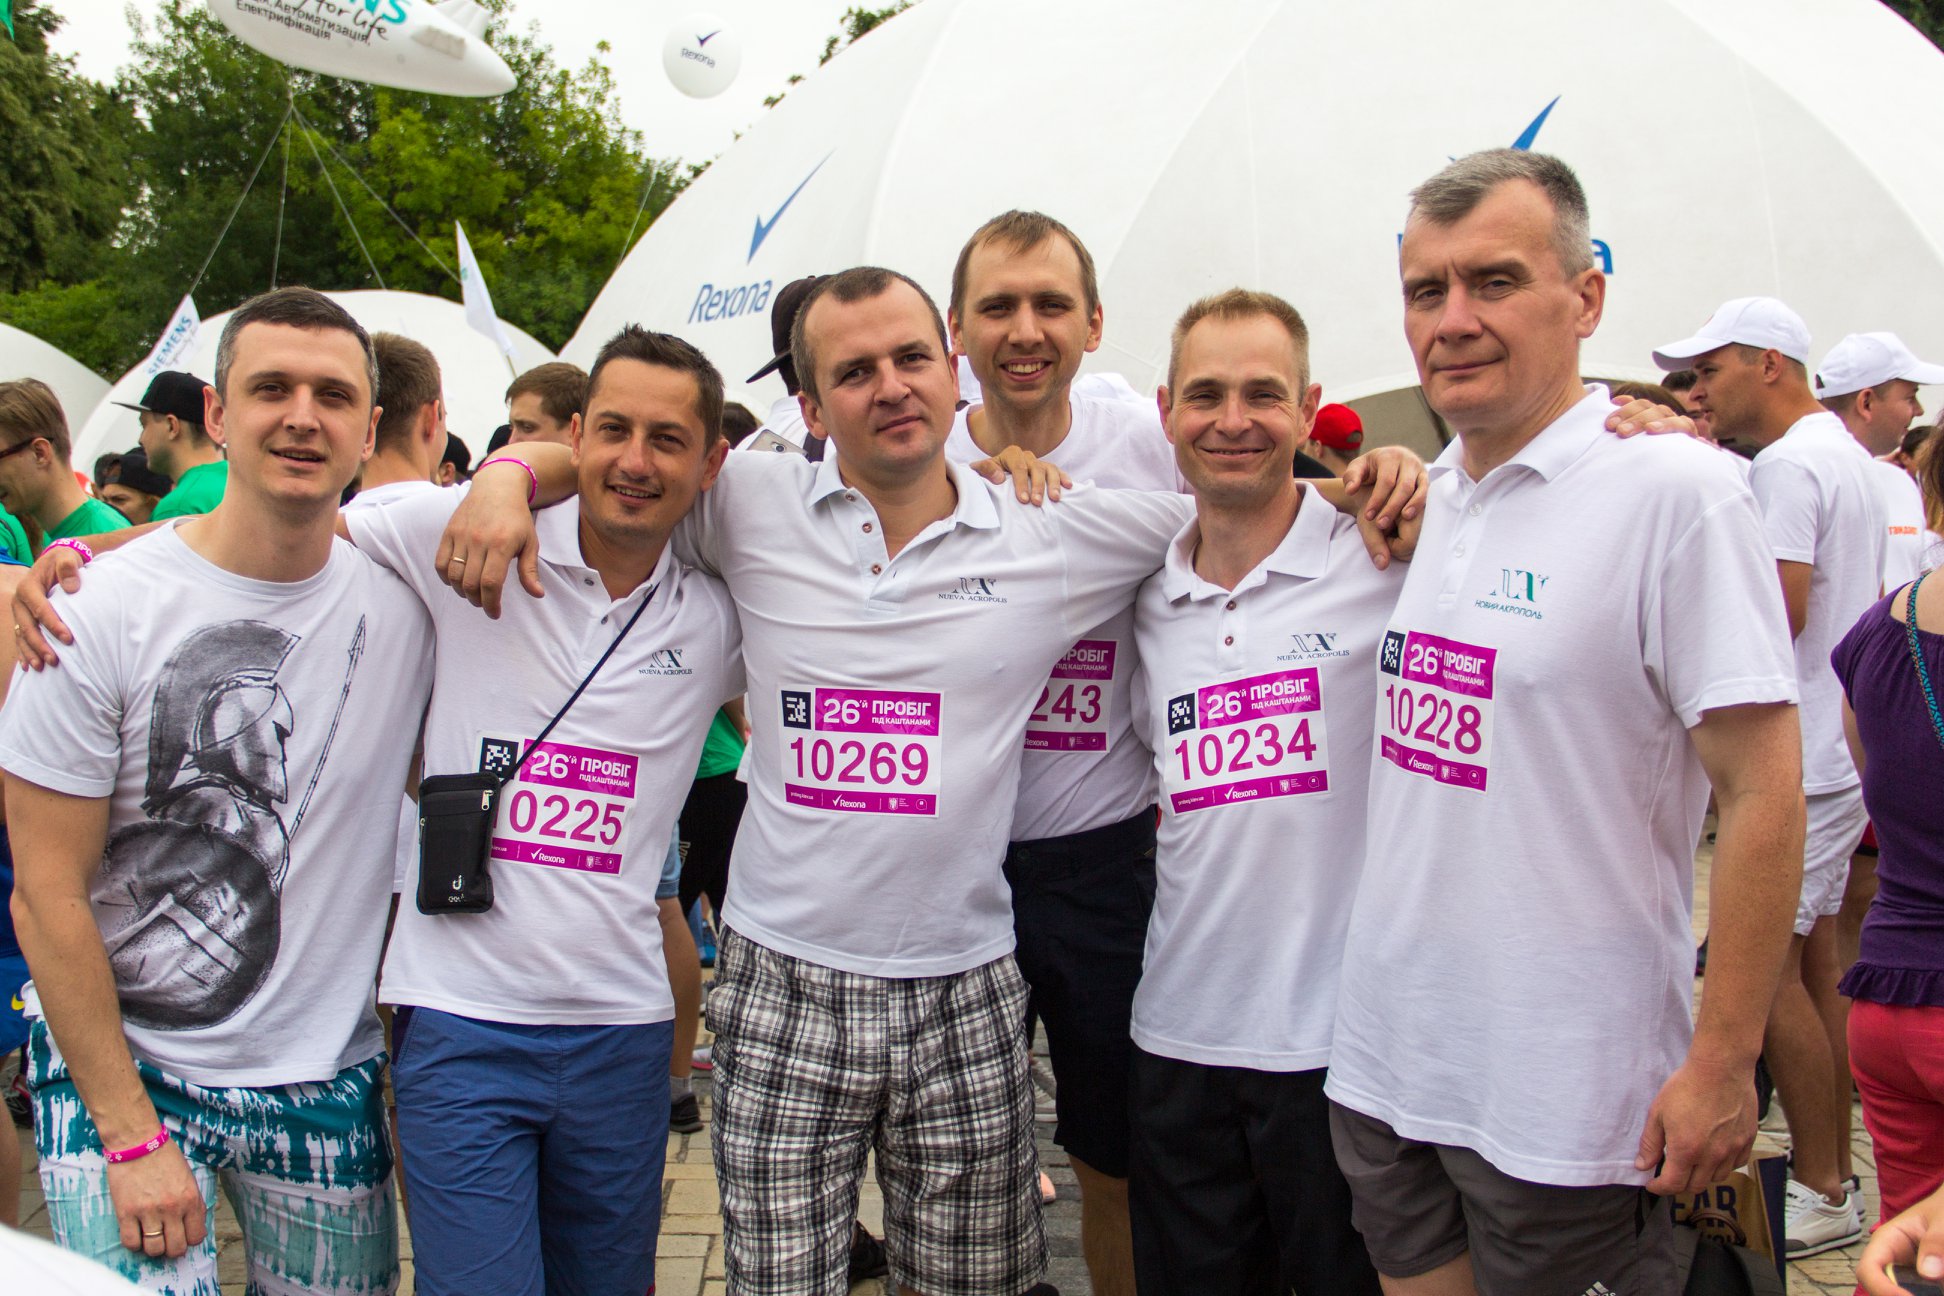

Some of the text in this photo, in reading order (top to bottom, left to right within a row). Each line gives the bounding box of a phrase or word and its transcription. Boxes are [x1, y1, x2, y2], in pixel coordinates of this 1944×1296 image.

[236, 1, 331, 40] Електрифікація
[681, 47, 716, 69] Rexona
[687, 280, 772, 324] Rexona
[148, 316, 192, 374] SIEMENS
[968, 595, 1008, 603] ACROPOLIS
[1499, 605, 1543, 620] АКРОПОЛЬ
[1276, 649, 1350, 662] NUEVA ACROPOLIS
[1443, 649, 1486, 675] ПРОБІГ
[663, 668, 693, 676] ACROPOLIS
[1250, 678, 1309, 701] ПРОБІГ
[871, 699, 931, 717] ПРОБІГ
[1251, 694, 1312, 710] ПІД КАШТАНАМИ
[871, 717, 931, 726] ПІД КАШТАНАМИ
[1386, 683, 1482, 755] 10228
[1174, 718, 1317, 781] 10234
[580, 757, 632, 778] ПРОБІГ
[790, 736, 929, 786] 10269
[579, 774, 630, 788] ПІД КАШТАНАМИ
[1232, 787, 1258, 799] Rexona
[839, 799, 867, 809] Rexona
[538, 852, 566, 865] Rexona
